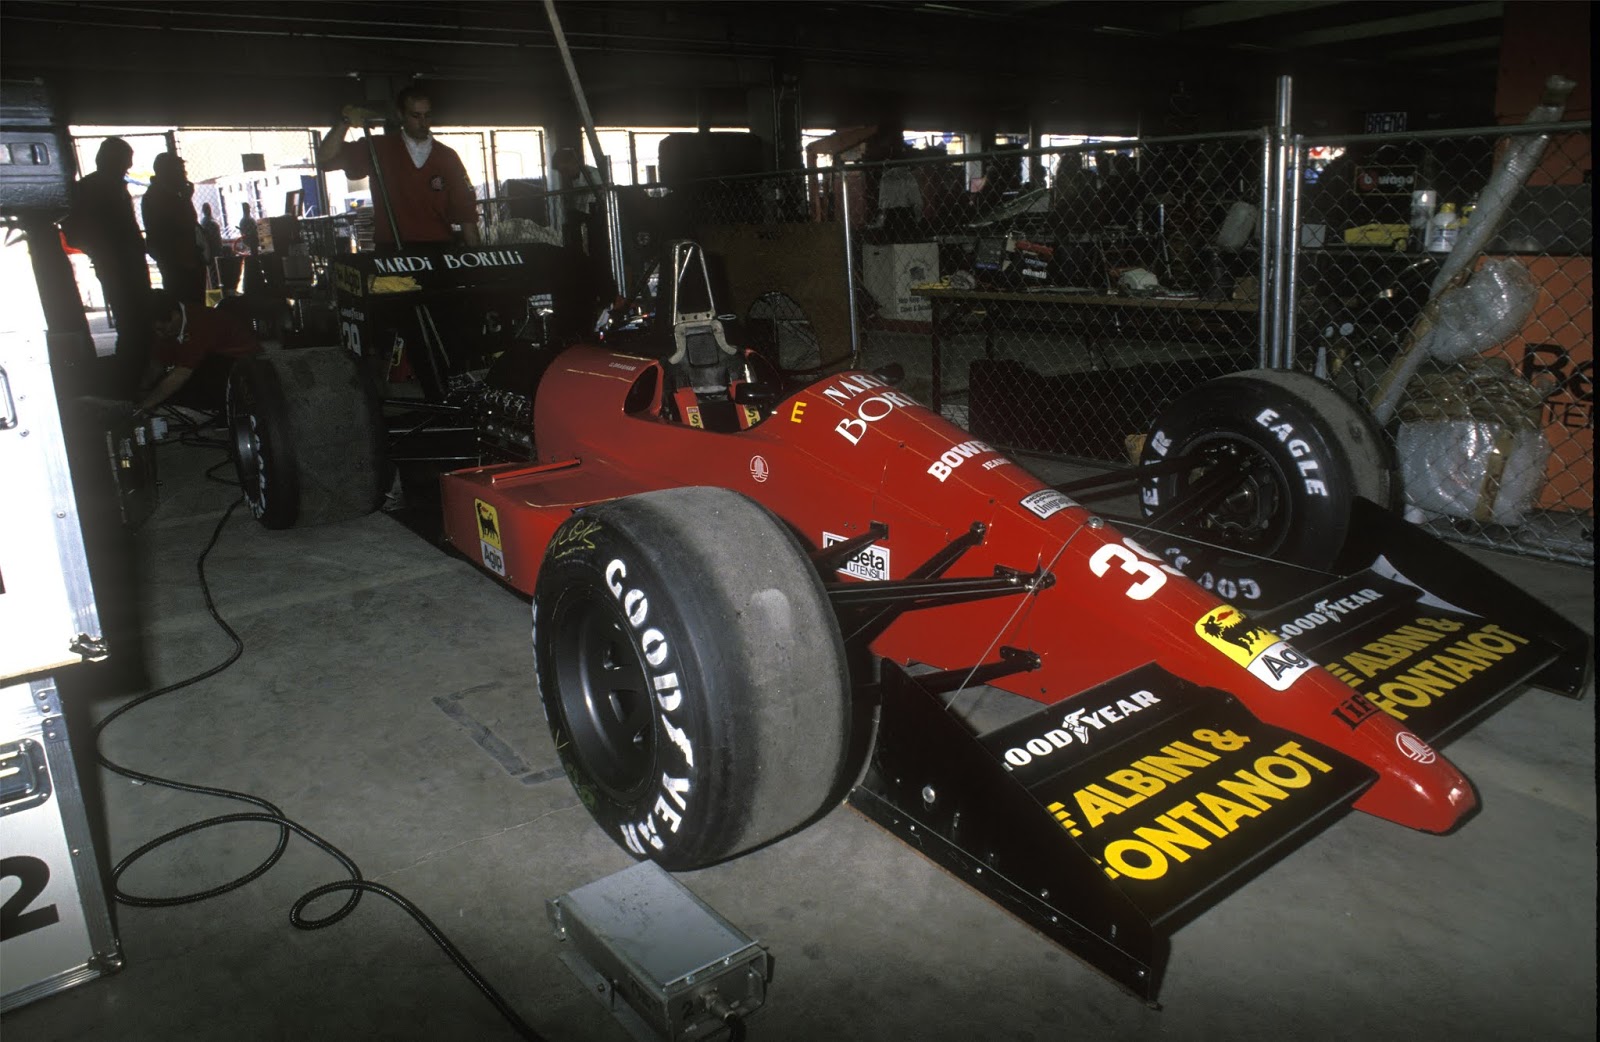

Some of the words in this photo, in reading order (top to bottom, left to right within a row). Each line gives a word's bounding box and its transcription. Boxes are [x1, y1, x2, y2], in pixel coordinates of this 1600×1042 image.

[790, 401, 807, 424] E
[1255, 407, 1329, 497] EAGLE
[1343, 624, 1446, 679] ALBINI
[1073, 740, 1222, 828] ALBINI
[1094, 740, 1334, 881] ONTANOT
